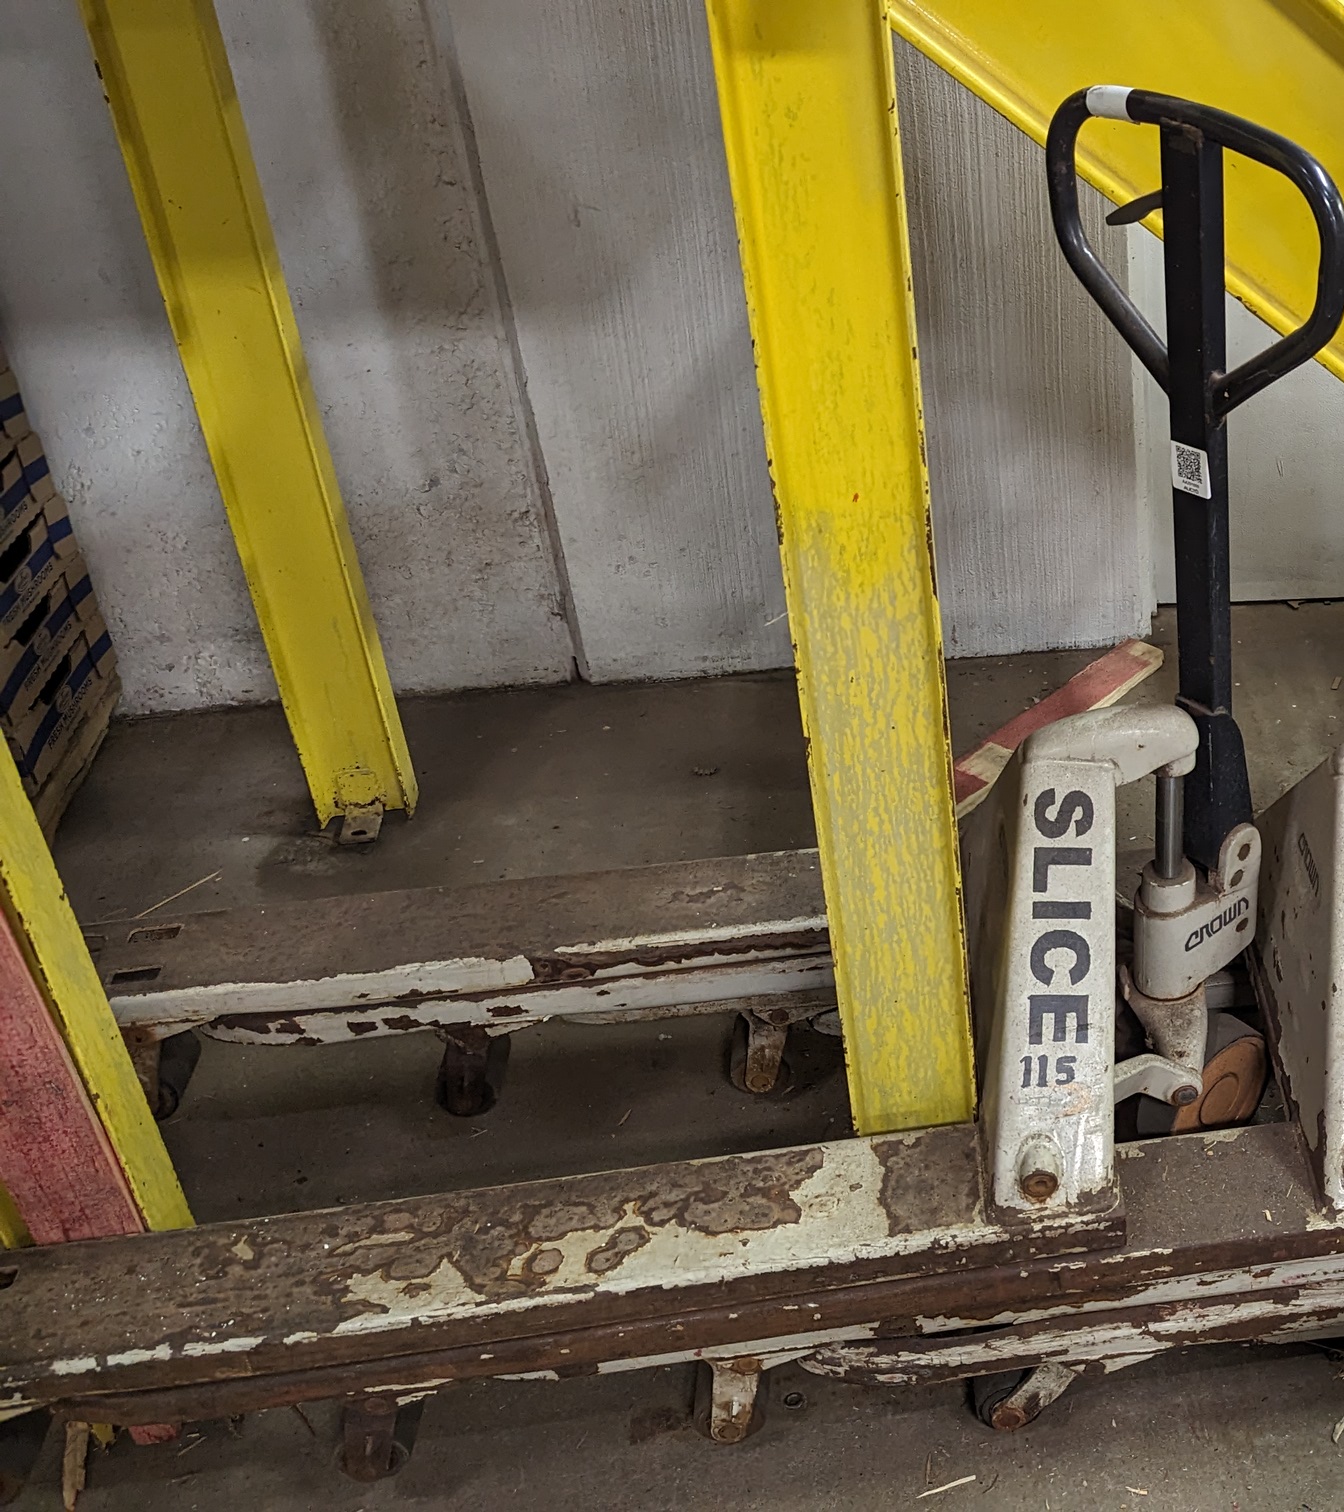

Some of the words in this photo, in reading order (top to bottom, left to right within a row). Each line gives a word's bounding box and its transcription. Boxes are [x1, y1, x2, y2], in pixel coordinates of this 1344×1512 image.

[60, 676, 94, 725] MUSHROOMS
[1027, 787, 1095, 1046] SLICE
[1184, 896, 1250, 953] CROWN
[1019, 1054, 1078, 1089] 115
